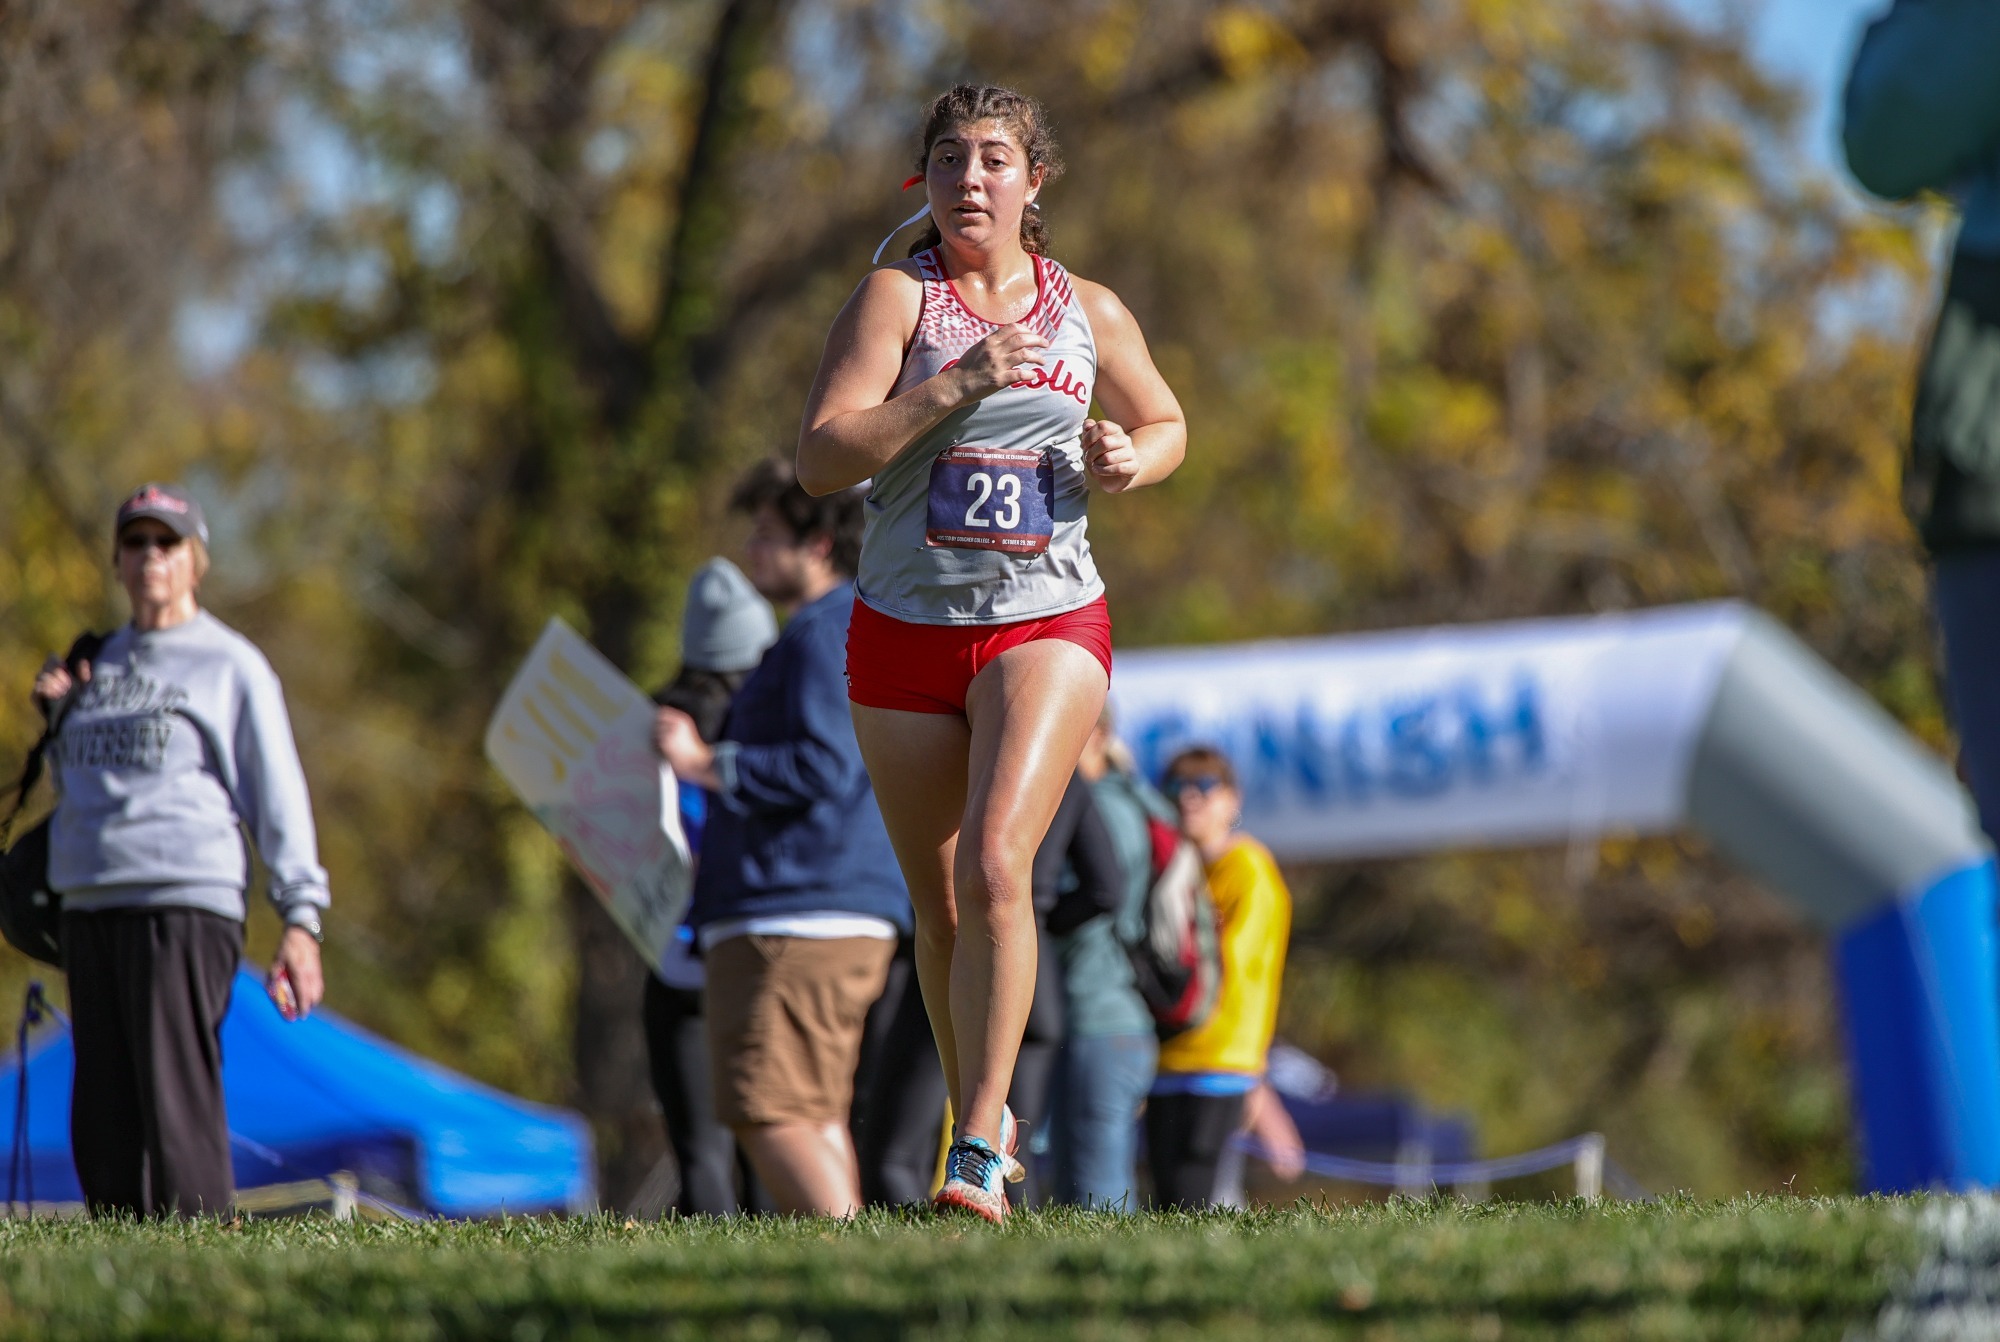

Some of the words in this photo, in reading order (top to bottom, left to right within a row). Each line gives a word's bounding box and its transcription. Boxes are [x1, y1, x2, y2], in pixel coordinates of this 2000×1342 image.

[938, 359, 1087, 404] olic
[983, 453, 1005, 461] CONFERENCE
[965, 472, 1021, 529] 23
